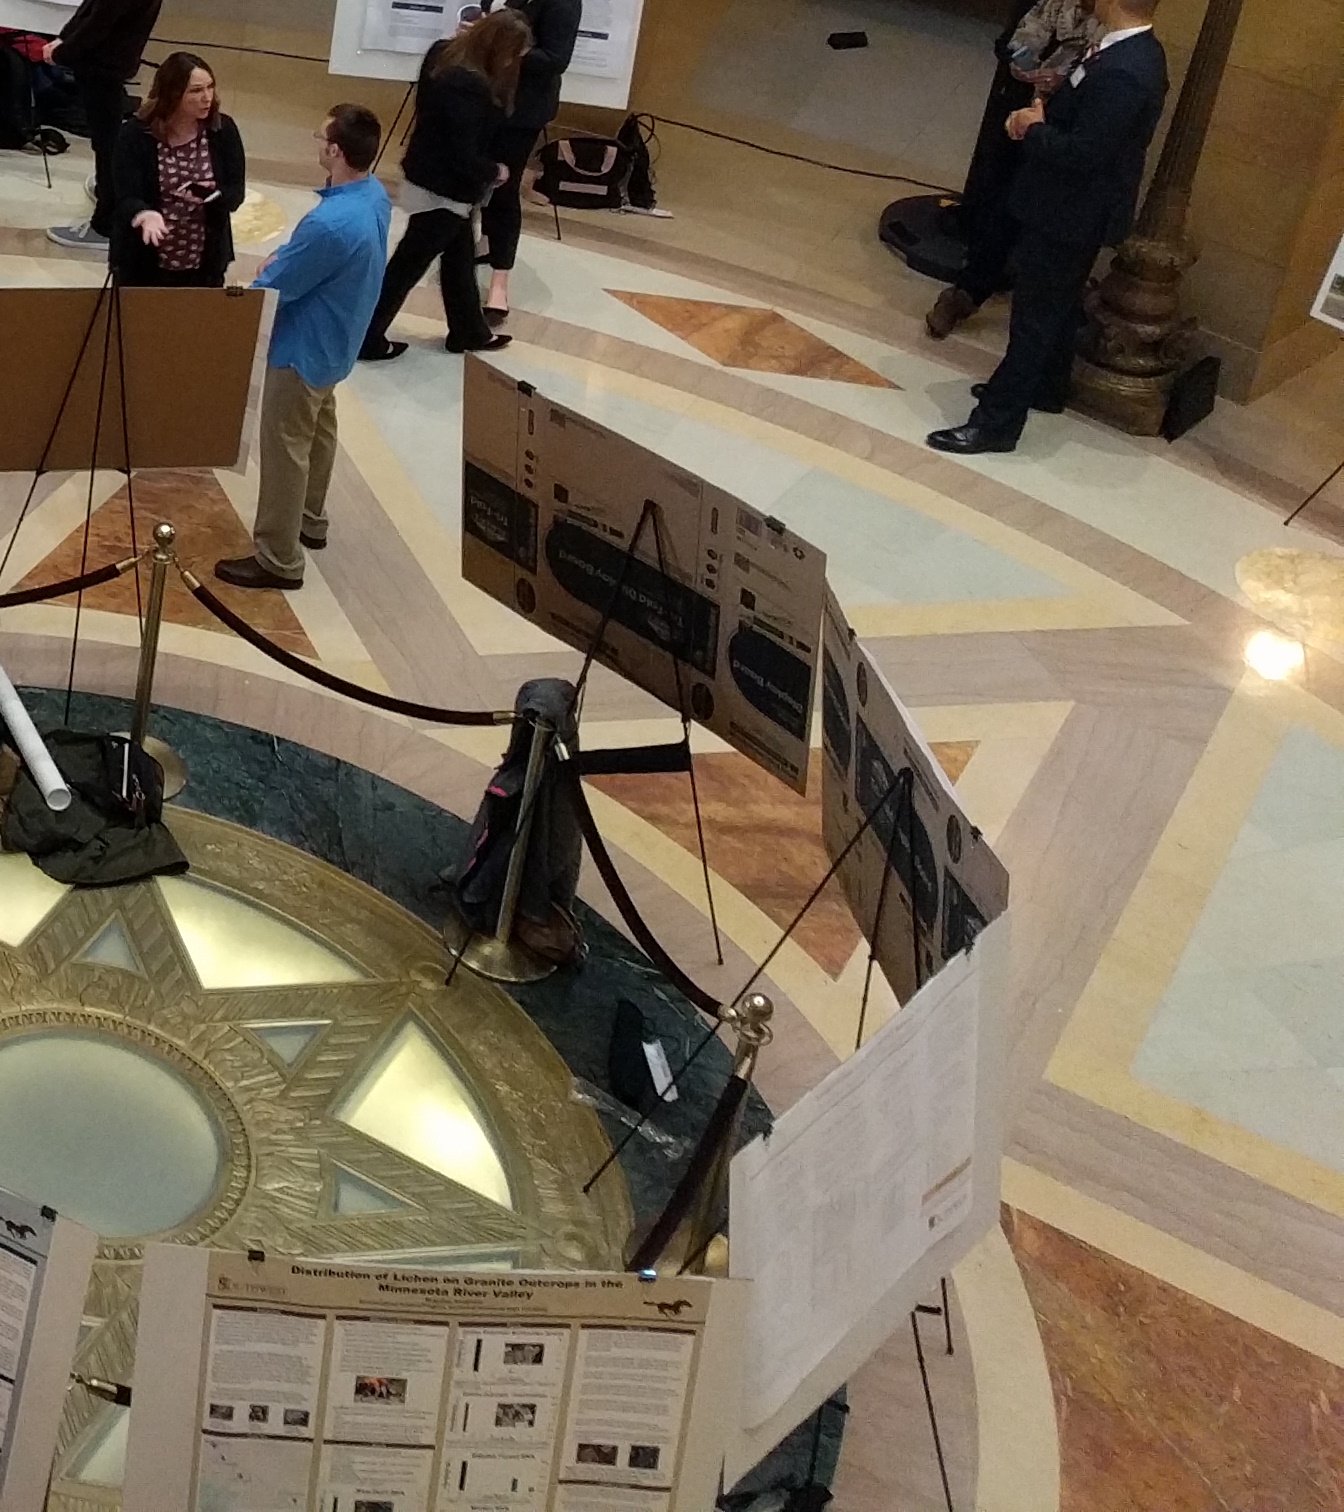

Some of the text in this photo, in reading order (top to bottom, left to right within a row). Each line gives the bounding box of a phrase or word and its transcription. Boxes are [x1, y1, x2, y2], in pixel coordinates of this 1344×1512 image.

[291, 1265, 624, 1290] Distribution of Lichen on Granite Outcrops in the
[377, 1283, 534, 1300] Minnesota River Valley
